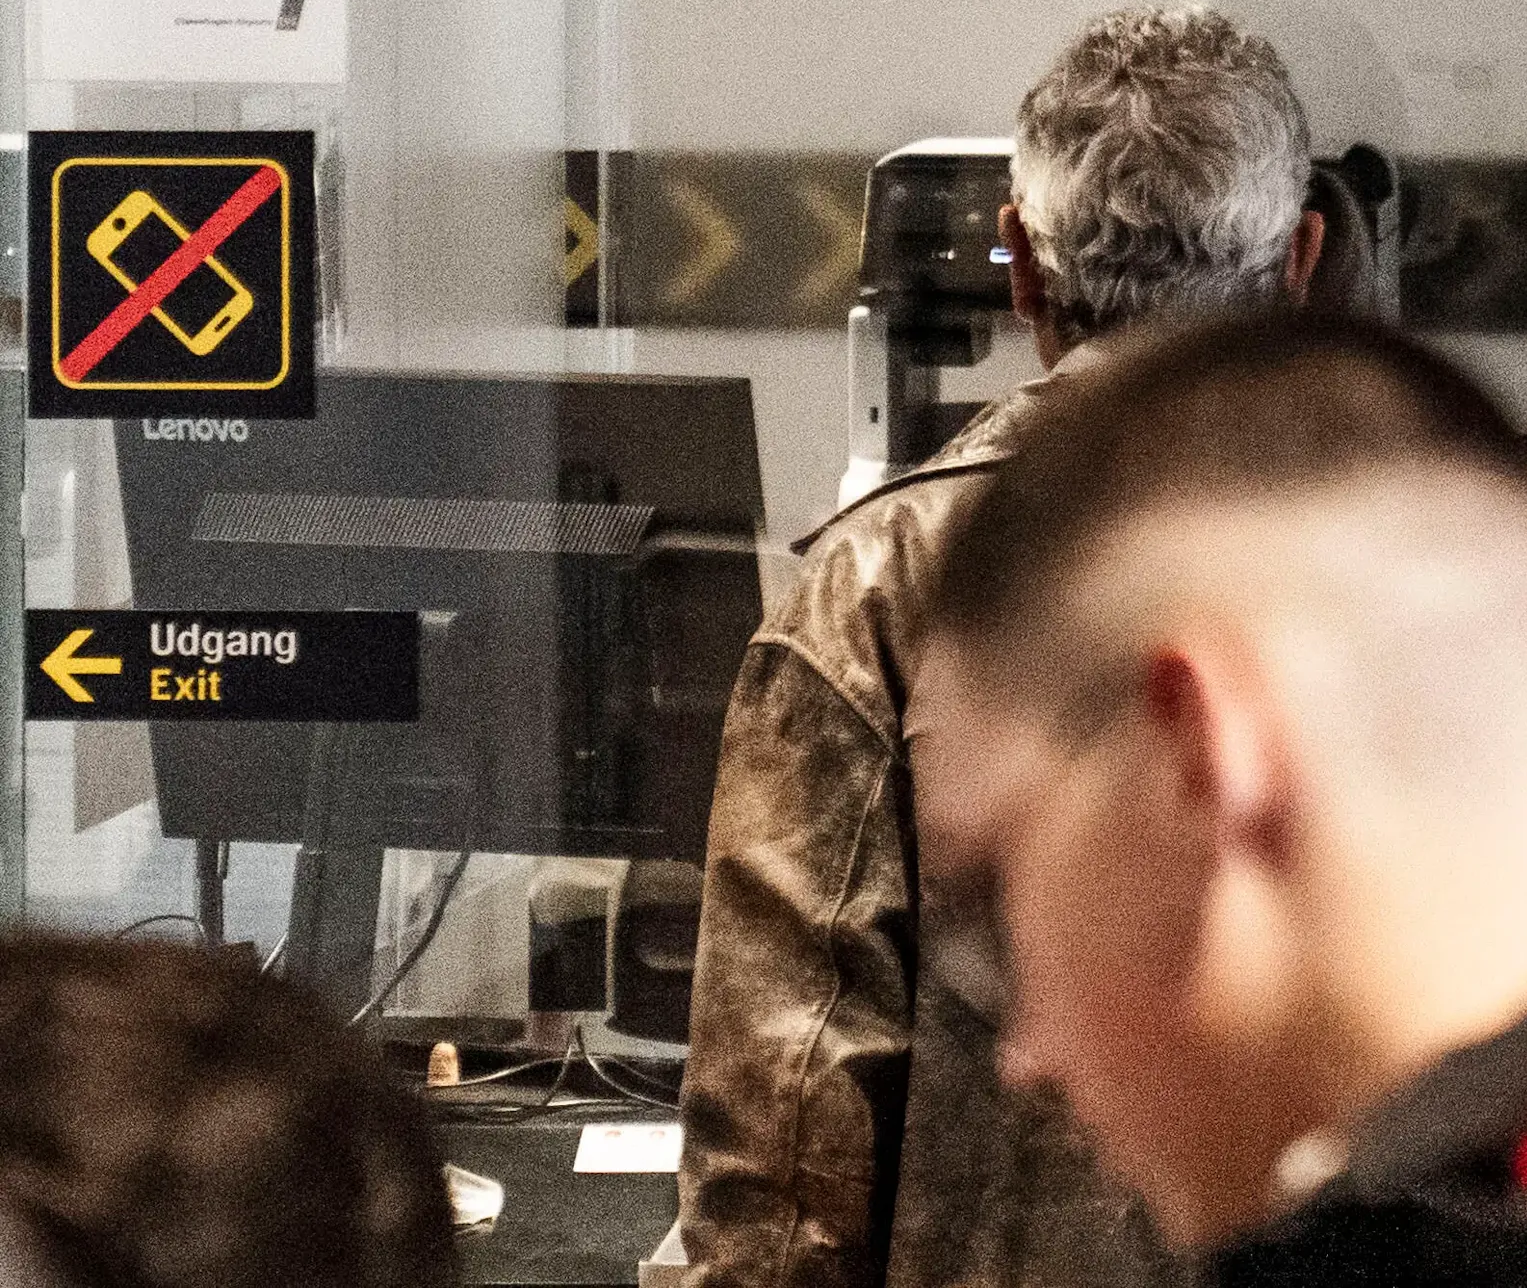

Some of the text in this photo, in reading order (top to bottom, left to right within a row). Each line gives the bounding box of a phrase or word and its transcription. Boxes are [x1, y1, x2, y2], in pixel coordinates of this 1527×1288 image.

[142, 418, 249, 442] Lenovo
[151, 623, 296, 664] Udgang
[151, 667, 222, 701] Exit
